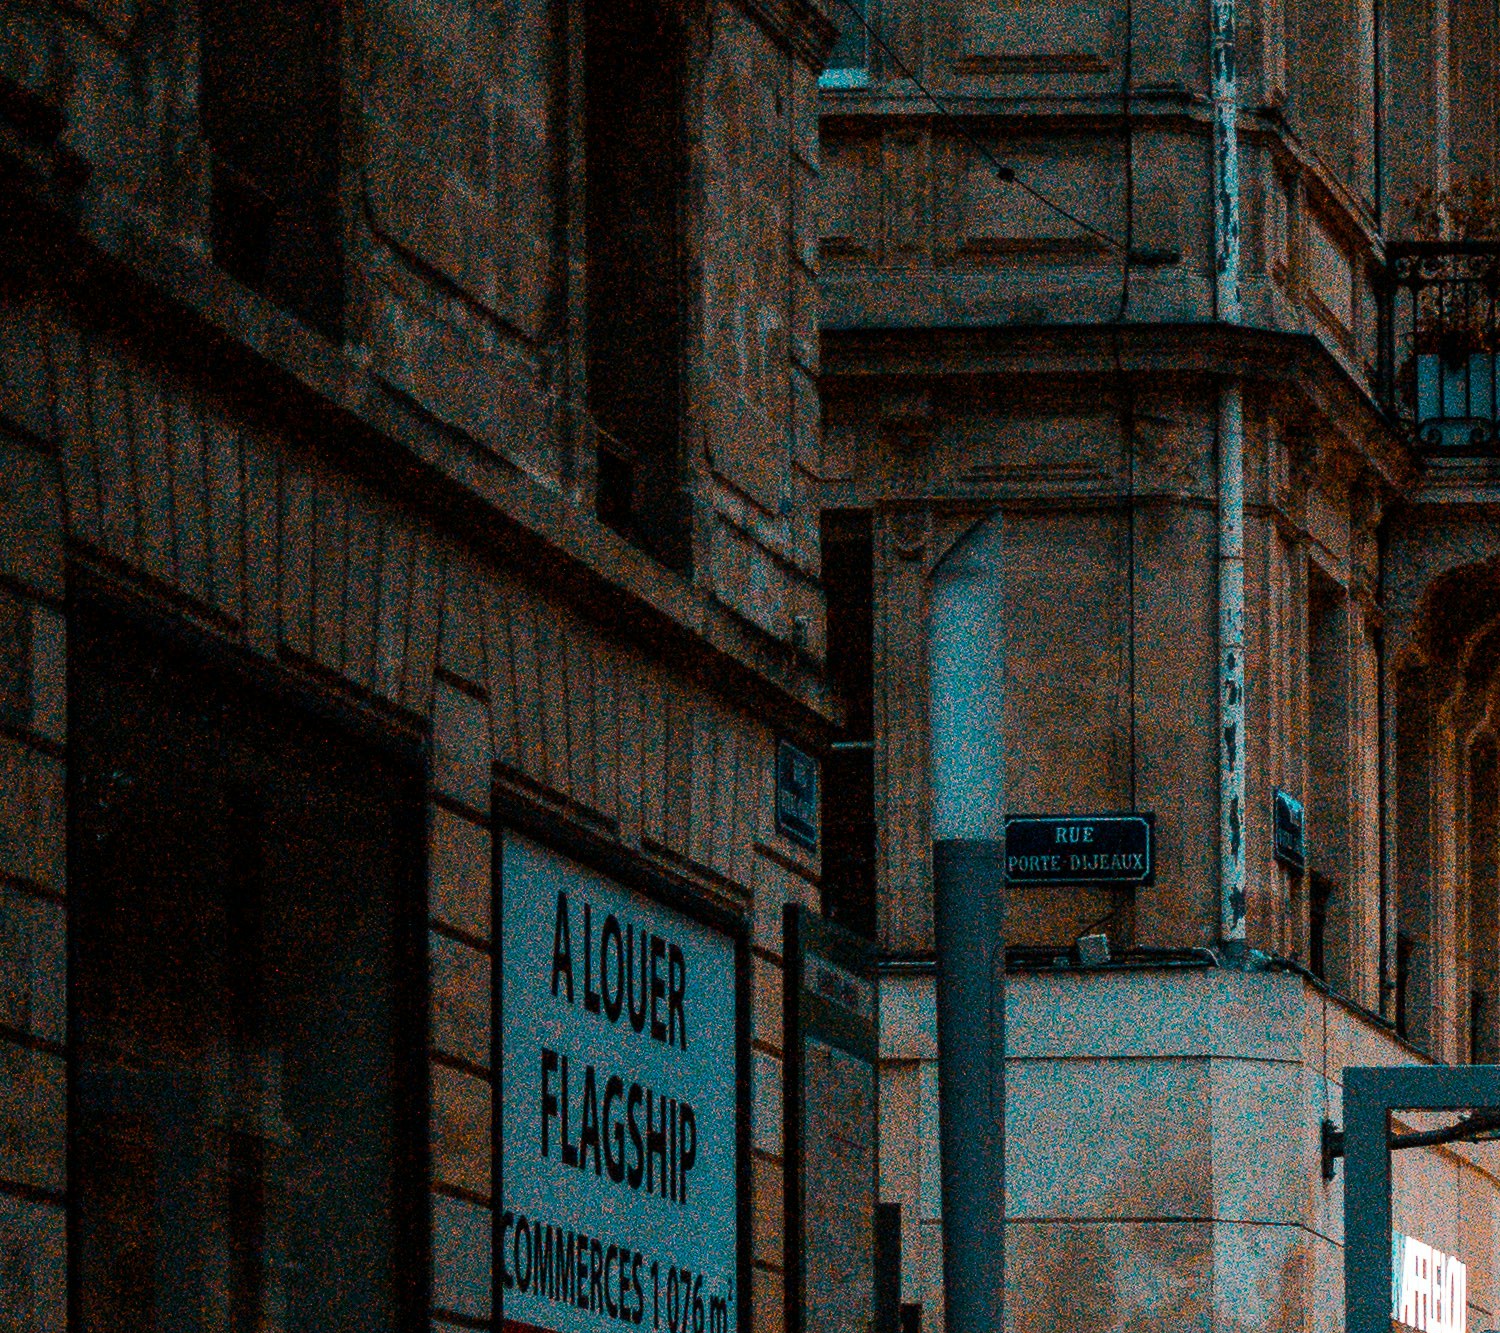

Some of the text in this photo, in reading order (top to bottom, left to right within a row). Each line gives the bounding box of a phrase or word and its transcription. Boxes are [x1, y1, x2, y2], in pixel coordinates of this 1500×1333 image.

[1007, 853, 1144, 873] PORTE-DIJEAUX
[1054, 825, 1096, 845] RUE
[551, 889, 574, 1003] A
[584, 902, 688, 1052] LOUER
[541, 1046, 698, 1206] FLAGSHIP
[500, 1209, 645, 1327] COMMERCES
[649, 1260, 660, 1330] 1
